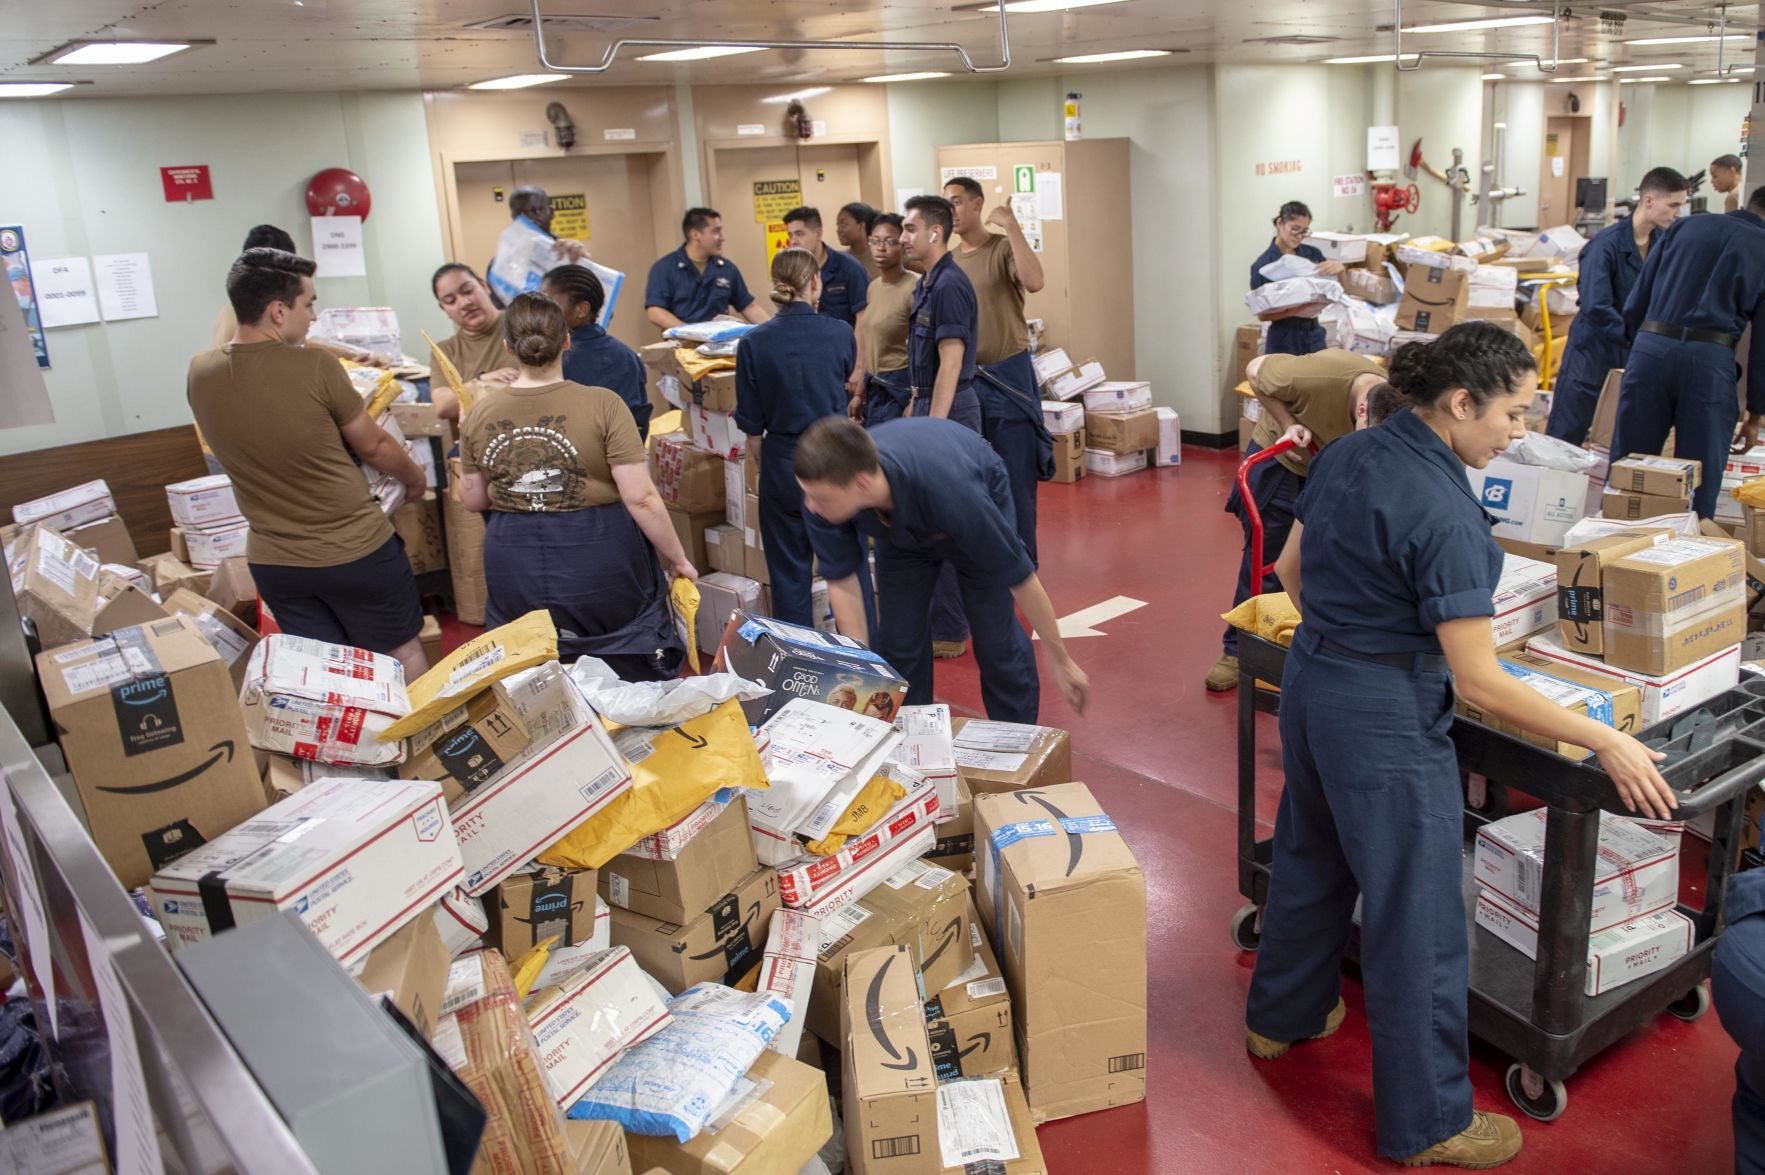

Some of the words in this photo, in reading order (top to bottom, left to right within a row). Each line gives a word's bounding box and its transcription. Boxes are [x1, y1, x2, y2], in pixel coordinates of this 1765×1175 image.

[943, 168, 955, 178] LIFE
[956, 167, 994, 178] PRESERVERS
[1255, 163, 1266, 176] NO
[1268, 160, 1302, 175] SMOKING
[755, 182, 799, 194] CAUTION
[1334, 177, 1344, 186] FIRE
[1345, 175, 1364, 185] STATION
[551, 197, 584, 209] TION
[512, 426, 578, 458] COMFORT
[1568, 589, 1578, 616] prime
[1493, 617, 1520, 633] PRIORITY
[1499, 628, 1513, 637] MAIL
[793, 671, 818, 684] GOOD
[120, 677, 166, 700] prime
[271, 725, 294, 737] MAIL
[851, 804, 869, 823] JM8
[454, 811, 484, 838] ORITY
[459, 829, 479, 845] AIL
[534, 898, 568, 913] prime
[813, 887, 855, 917] PRIORITY
[307, 906, 338, 930] IORITY
[1478, 901, 1512, 926] PRIORITY
[1484, 912, 1503, 928] MAIL
[169, 923, 205, 935] PRIORITY
[179, 932, 199, 942] MAIL
[729, 946, 749, 968] prime
[1625, 946, 1661, 964] PRIORITY
[1633, 957, 1651, 968] MAIL
[537, 1020, 558, 1036] UNITED
[560, 1011, 582, 1030] SERVICE
[543, 1038, 572, 1064] IORITY
[545, 1054, 567, 1072] MAIL
